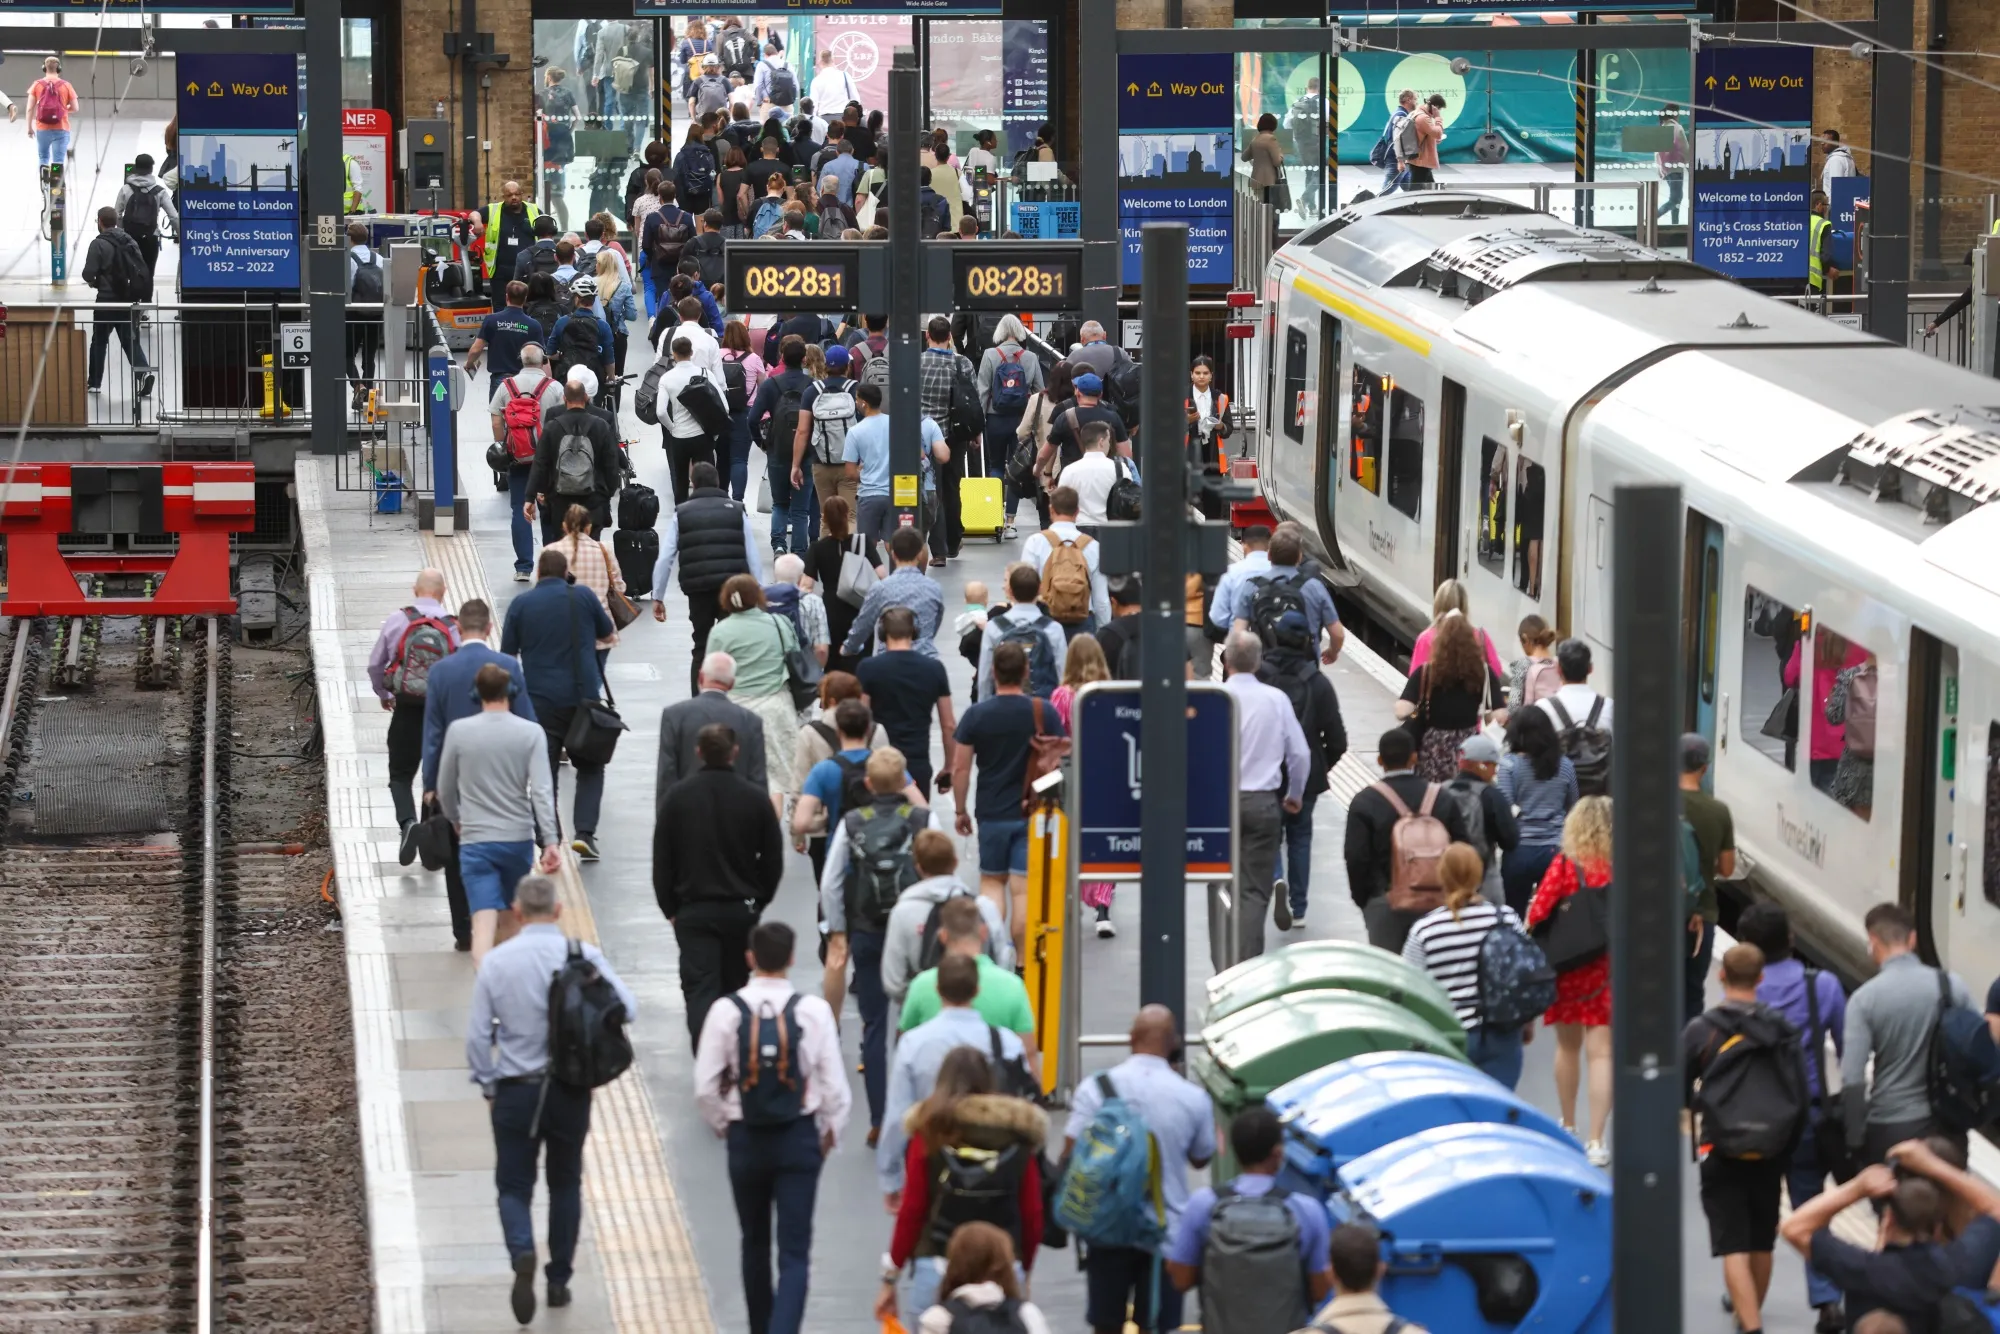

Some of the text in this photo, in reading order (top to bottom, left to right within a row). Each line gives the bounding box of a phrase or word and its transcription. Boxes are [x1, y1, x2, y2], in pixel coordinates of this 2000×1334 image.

[929, 33, 963, 43] ondon
[1748, 75, 1804, 90] Way Out
[231, 83, 260, 97] Way
[263, 83, 288, 95] Out
[1170, 82, 1224, 97] Way Out
[342, 112, 376, 126] NER
[1123, 198, 1227, 208] Welcome to London
[1699, 192, 1804, 203] Welcome to London
[185, 200, 293, 210] Welcome to London
[1188, 227, 1227, 237] Station
[1699, 221, 1803, 234] King's Cross Station
[186, 230, 293, 242] King's Cross Station
[1703, 235, 1799, 248] 170th Anniversary
[190, 244, 290, 258] 170th Anniversary
[1717, 253, 1744, 262] 1852
[1756, 252, 1783, 262] 2022
[206, 262, 234, 272] 1852
[247, 262, 275, 272] 2022
[1186, 259, 1208, 268] 022
[293, 336, 304, 349] 6
[1135, 333, 1143, 345] 7
[289, 355, 296, 363] R
[1115, 706, 1142, 720] King
[1106, 836, 1142, 852] Troll
